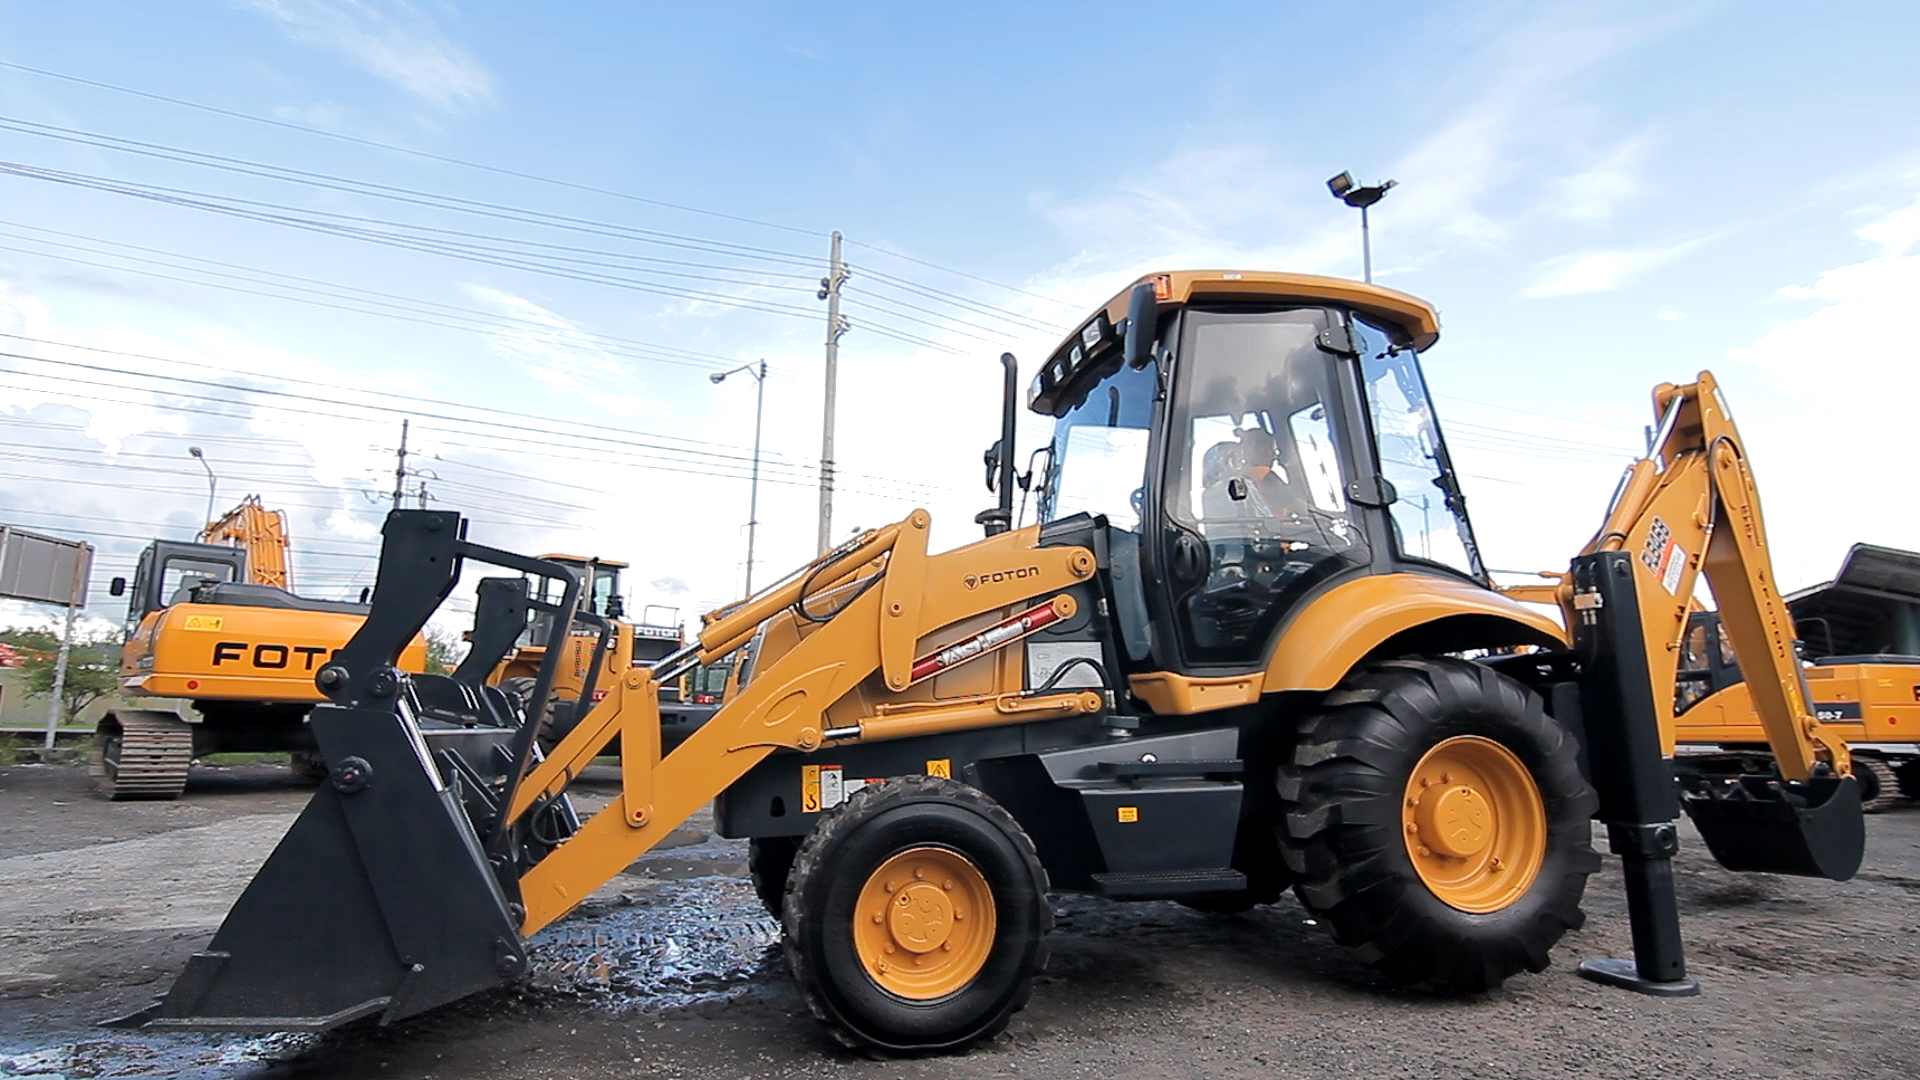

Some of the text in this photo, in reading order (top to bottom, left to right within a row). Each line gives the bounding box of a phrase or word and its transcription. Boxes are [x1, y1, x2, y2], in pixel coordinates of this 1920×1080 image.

[980, 566, 1039, 584] FOTON
[635, 626, 680, 638] FOTON
[212, 641, 341, 670] FOT
